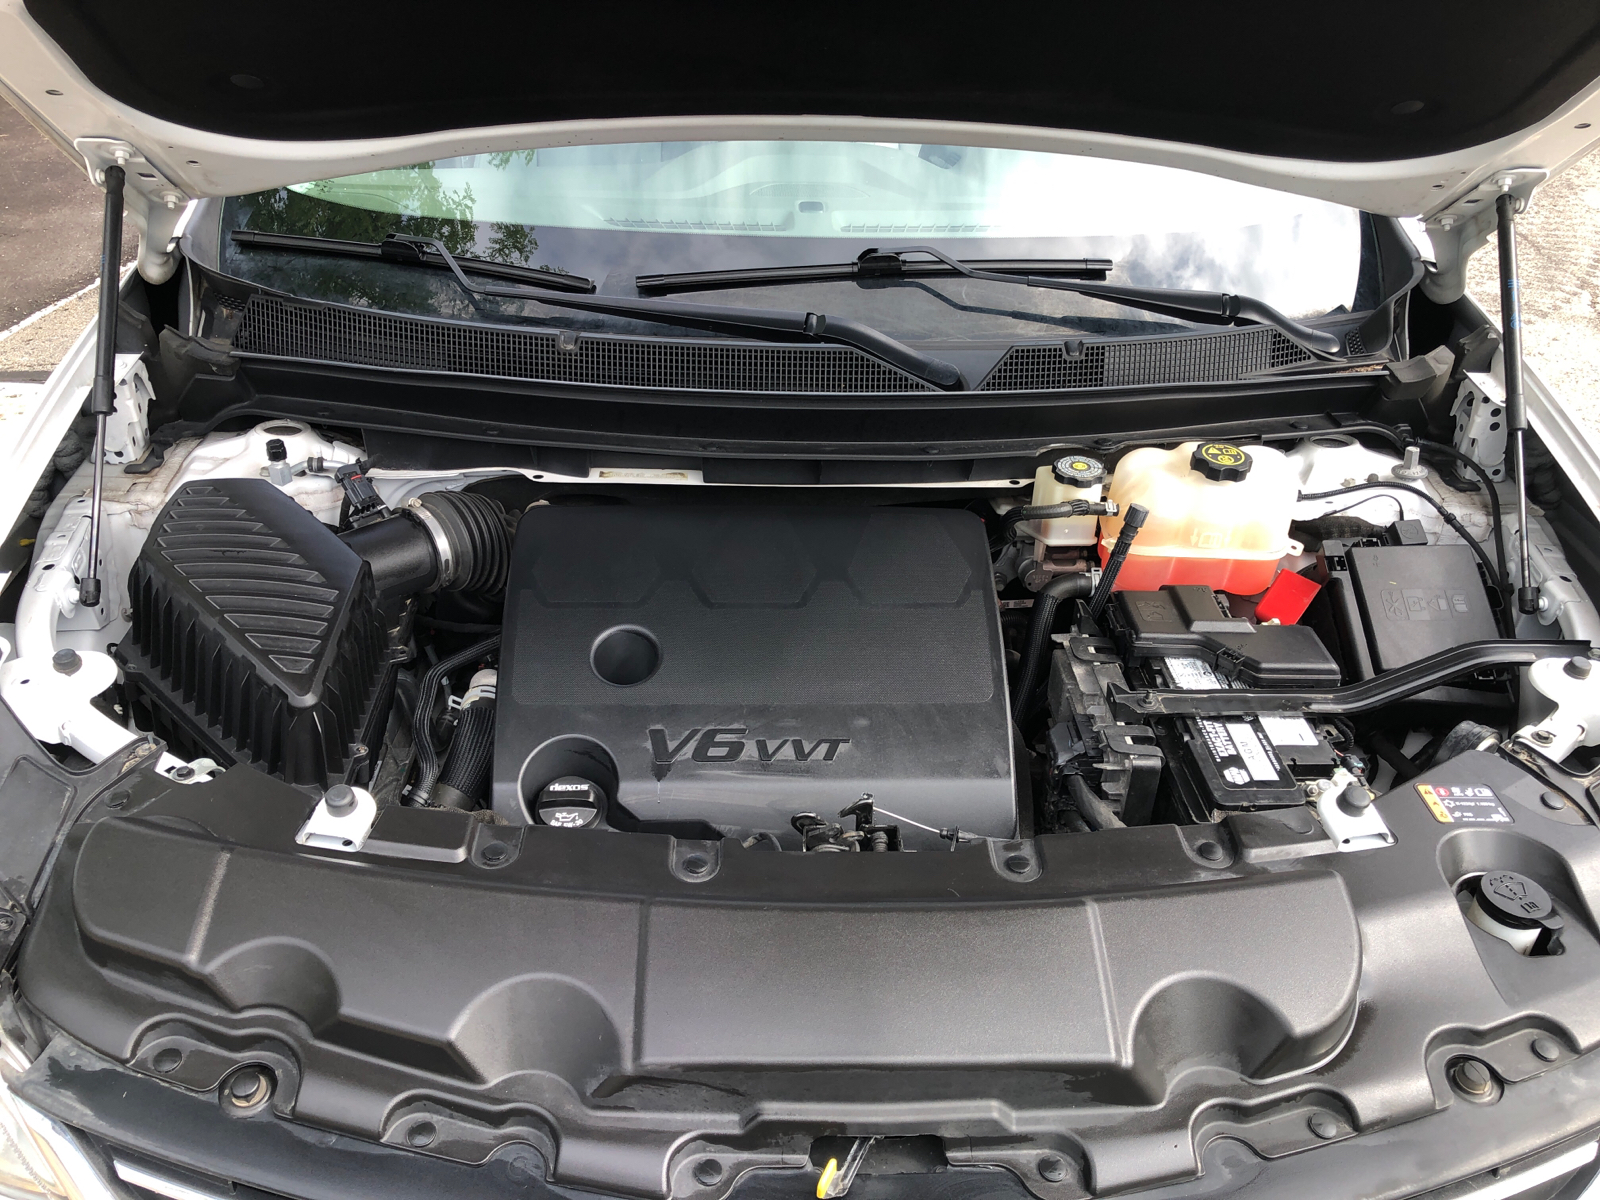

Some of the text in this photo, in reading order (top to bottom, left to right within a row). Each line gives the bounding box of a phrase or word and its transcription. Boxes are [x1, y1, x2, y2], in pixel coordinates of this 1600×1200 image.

[648, 727, 851, 763] V6 VVT
[1202, 720, 1229, 757] EXACT-FIT
[1212, 722, 1237, 755] BATTERY
[549, 783, 590, 791] dexos
